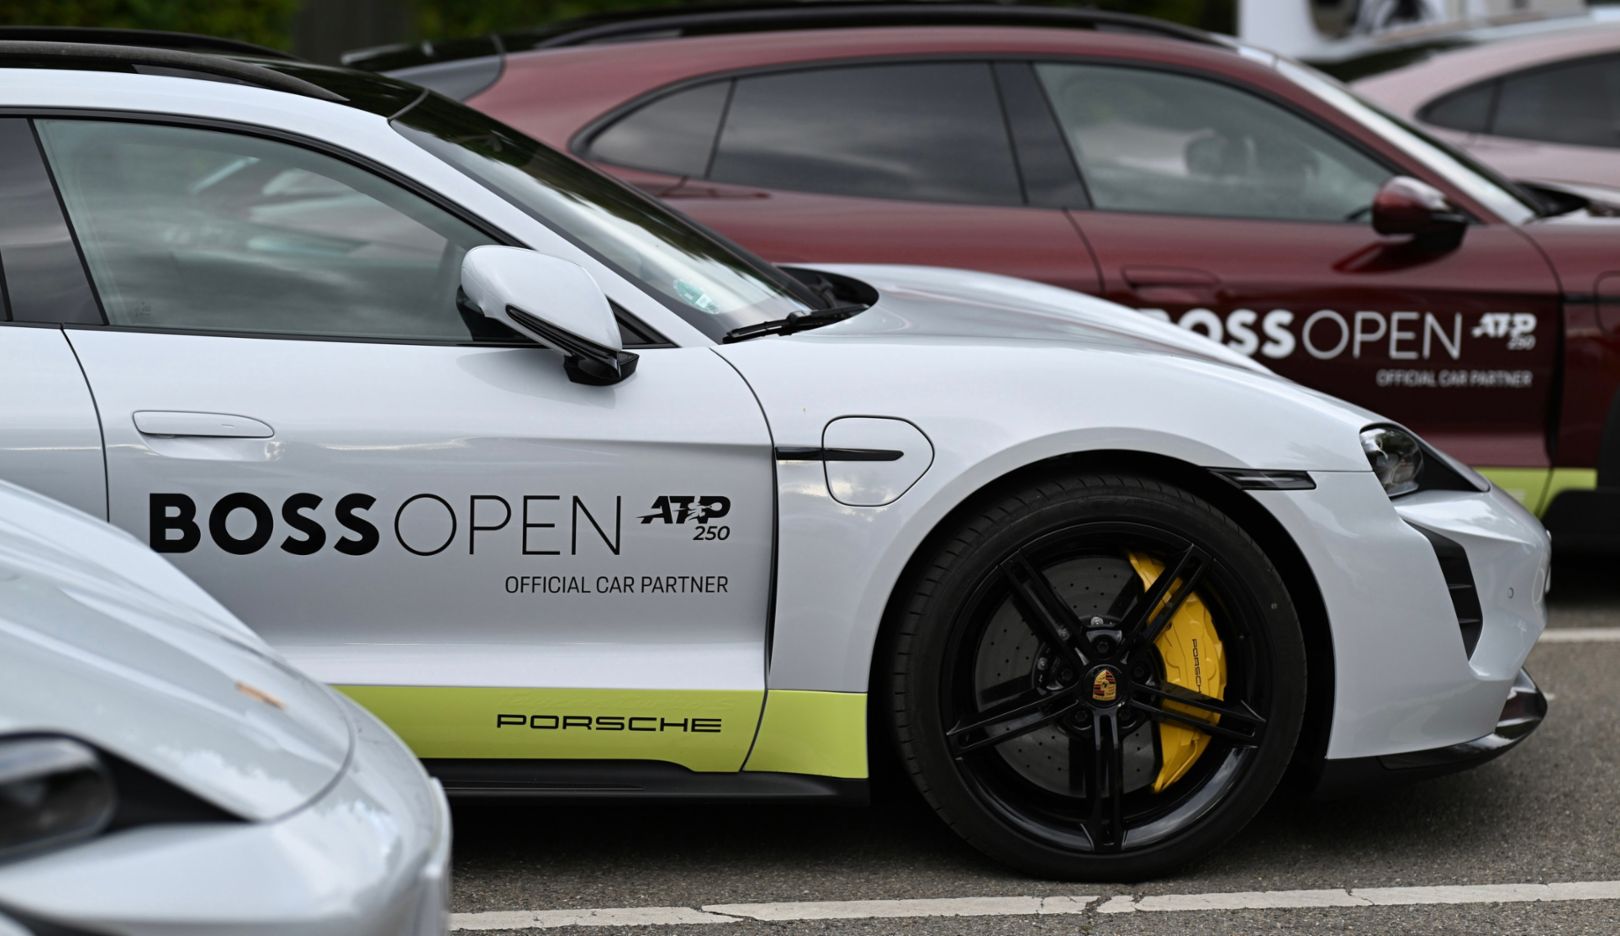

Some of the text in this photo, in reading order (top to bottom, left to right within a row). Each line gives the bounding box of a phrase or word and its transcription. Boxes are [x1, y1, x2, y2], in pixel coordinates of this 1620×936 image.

[1302, 309, 1463, 360] OPEN
[1472, 313, 1537, 338] ATP
[1508, 335, 1536, 351] 250
[1376, 368, 1533, 388] OFFICIAL CAR PARTNER
[636, 495, 731, 525] ATP
[149, 492, 622, 557] BOSS OPEN
[692, 525, 731, 541] 250
[505, 575, 729, 594] OFFICIAL CAR PARTNER
[496, 713, 722, 733] PORSCHE
